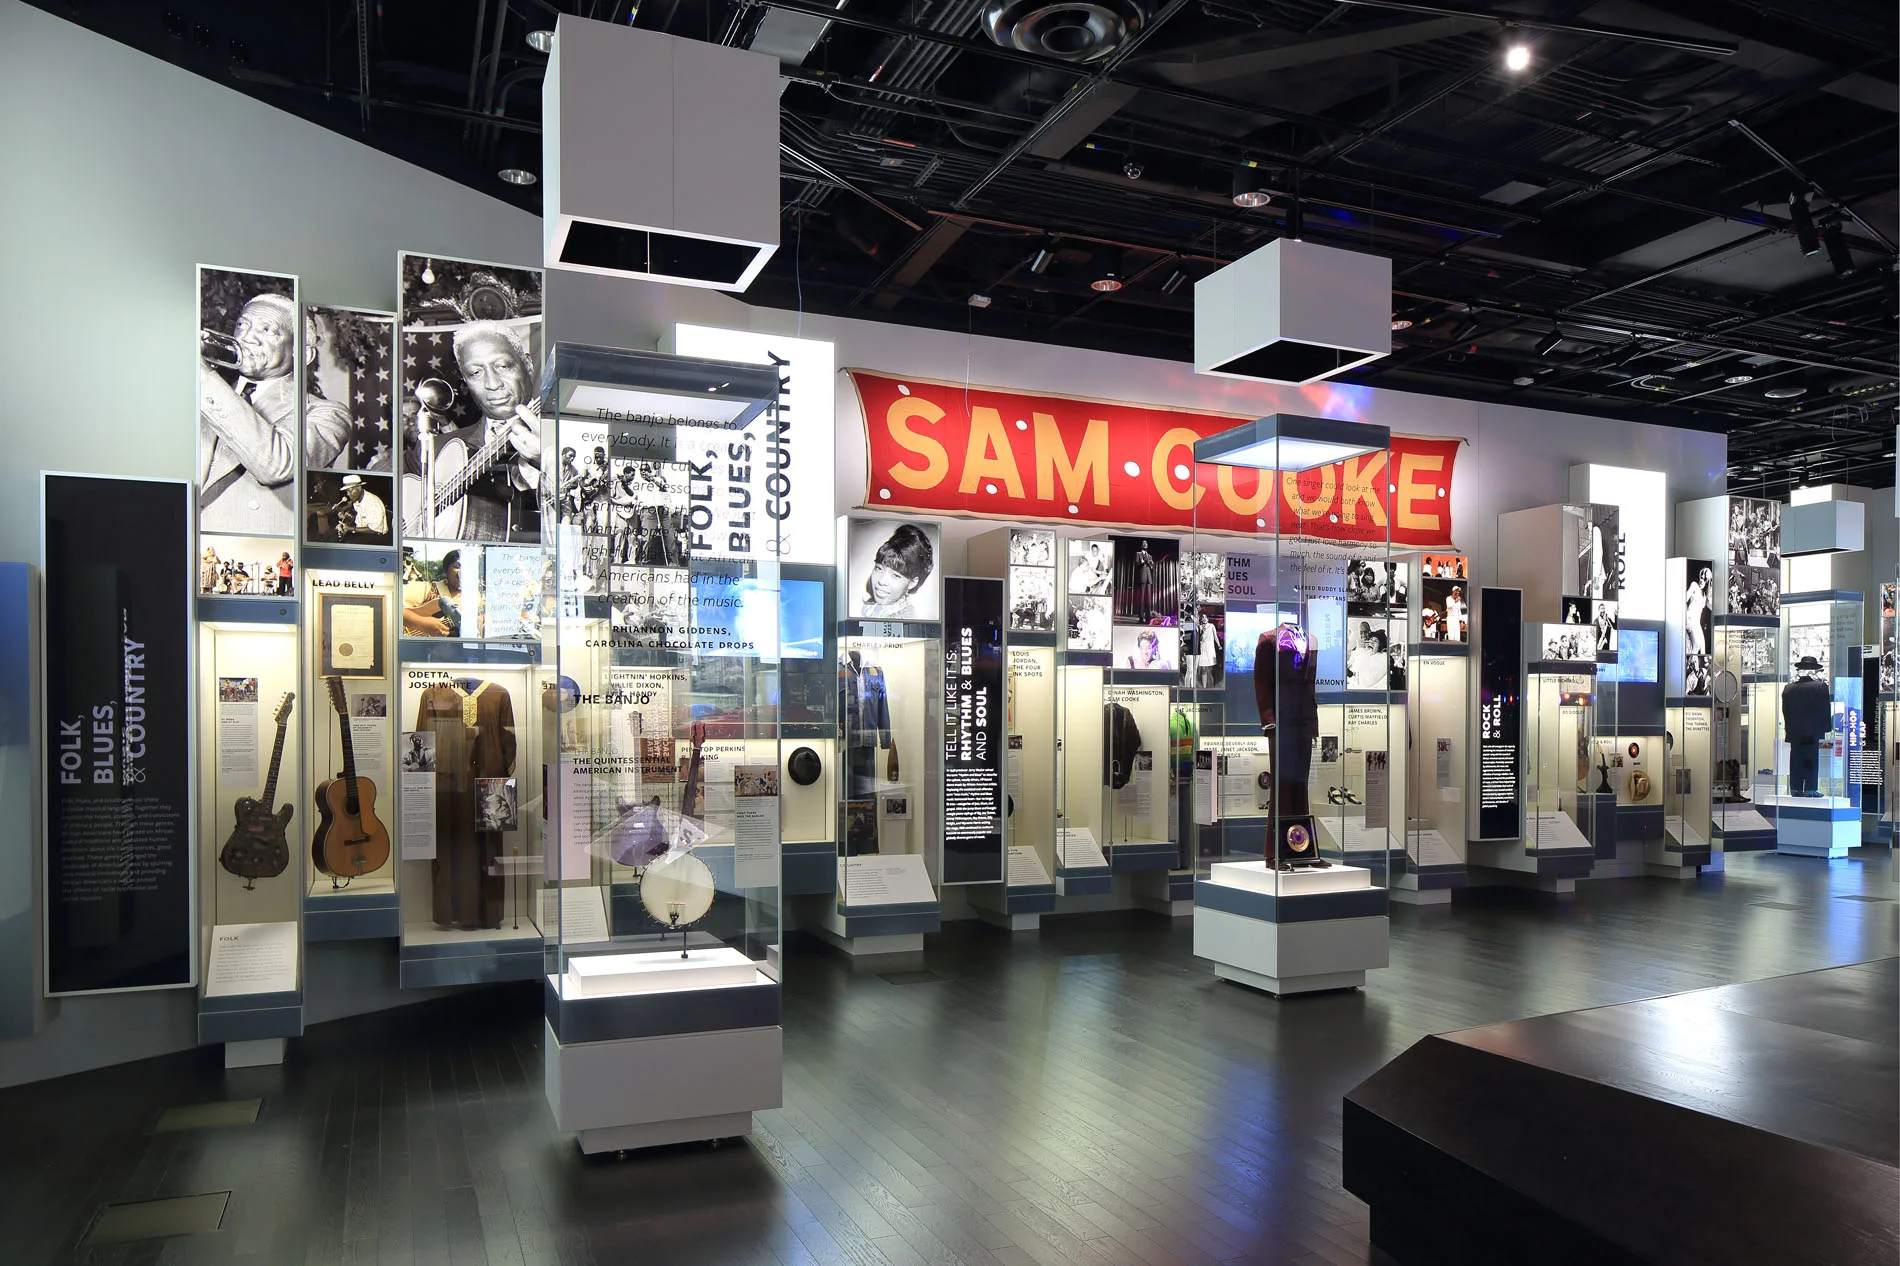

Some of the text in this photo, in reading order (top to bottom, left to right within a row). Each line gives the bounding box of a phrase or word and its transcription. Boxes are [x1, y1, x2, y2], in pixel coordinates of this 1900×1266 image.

[597, 407, 738, 433] The banjo belongs to
[581, 432, 656, 450] everybody.
[660, 436, 671, 448] It
[614, 456, 647, 469] clash
[886, 397, 1444, 531] SAM COOKE
[632, 481, 655, 492] are
[1286, 477, 1301, 485] One
[1303, 479, 1323, 490] singer
[1325, 481, 1344, 490] could
[1345, 483, 1360, 492] look
[689, 449, 718, 550] FOLK,
[728, 432, 756, 553] BLUES,
[1291, 492, 1304, 500] and
[1318, 495, 1339, 504] would
[1340, 497, 1356, 506] both
[1357, 498, 1376, 507] know
[1293, 506, 1310, 516] what
[1351, 512, 1359, 520] to
[1360, 513, 1374, 523] sing
[1339, 539, 1368, 550] harmony
[1290, 550, 1312, 560] much,
[1313, 551, 1325, 560] the
[1325, 552, 1347, 561] sound
[1290, 563, 1303, 572] the
[1303, 563, 1317, 573] feel
[1318, 564, 1326, 574] of
[312, 579, 375, 589] LEAD BELLY
[597, 569, 740, 586] Americans had in the
[1227, 585, 1256, 596] SOUL
[598, 591, 744, 609] creation of the music.
[612, 625, 731, 637] RHIANNON GIDDENS,
[585, 639, 755, 650] CAROLINA CHOCOLATE DROPS
[408, 671, 453, 680] ODETTA,
[649, 674, 688, 682] HOPKINS,
[408, 681, 472, 690] JOSH WHITE
[636, 682, 664, 690] DIXON,
[124, 637, 146, 759] COUNTRY
[573, 694, 651, 705] THE BANJO
[961, 627, 973, 760] RHYTHM & BLUES
[945, 650, 957, 760] TELL IT LIKE IT IS:
[976, 686, 987, 761] AND SOUL
[1482, 704, 1491, 739] ROCK
[1493, 694, 1501, 738] & ROLL
[1849, 710, 1857, 747] HIP-HOP
[60, 714, 86, 785] FOLK,
[92, 700, 118, 784] BLUES,
[572, 757, 592, 765] THE
[593, 757, 671, 766] QUINTESSENTIAL
[572, 765, 683, 775] AMERICAN INSTRUMENT
